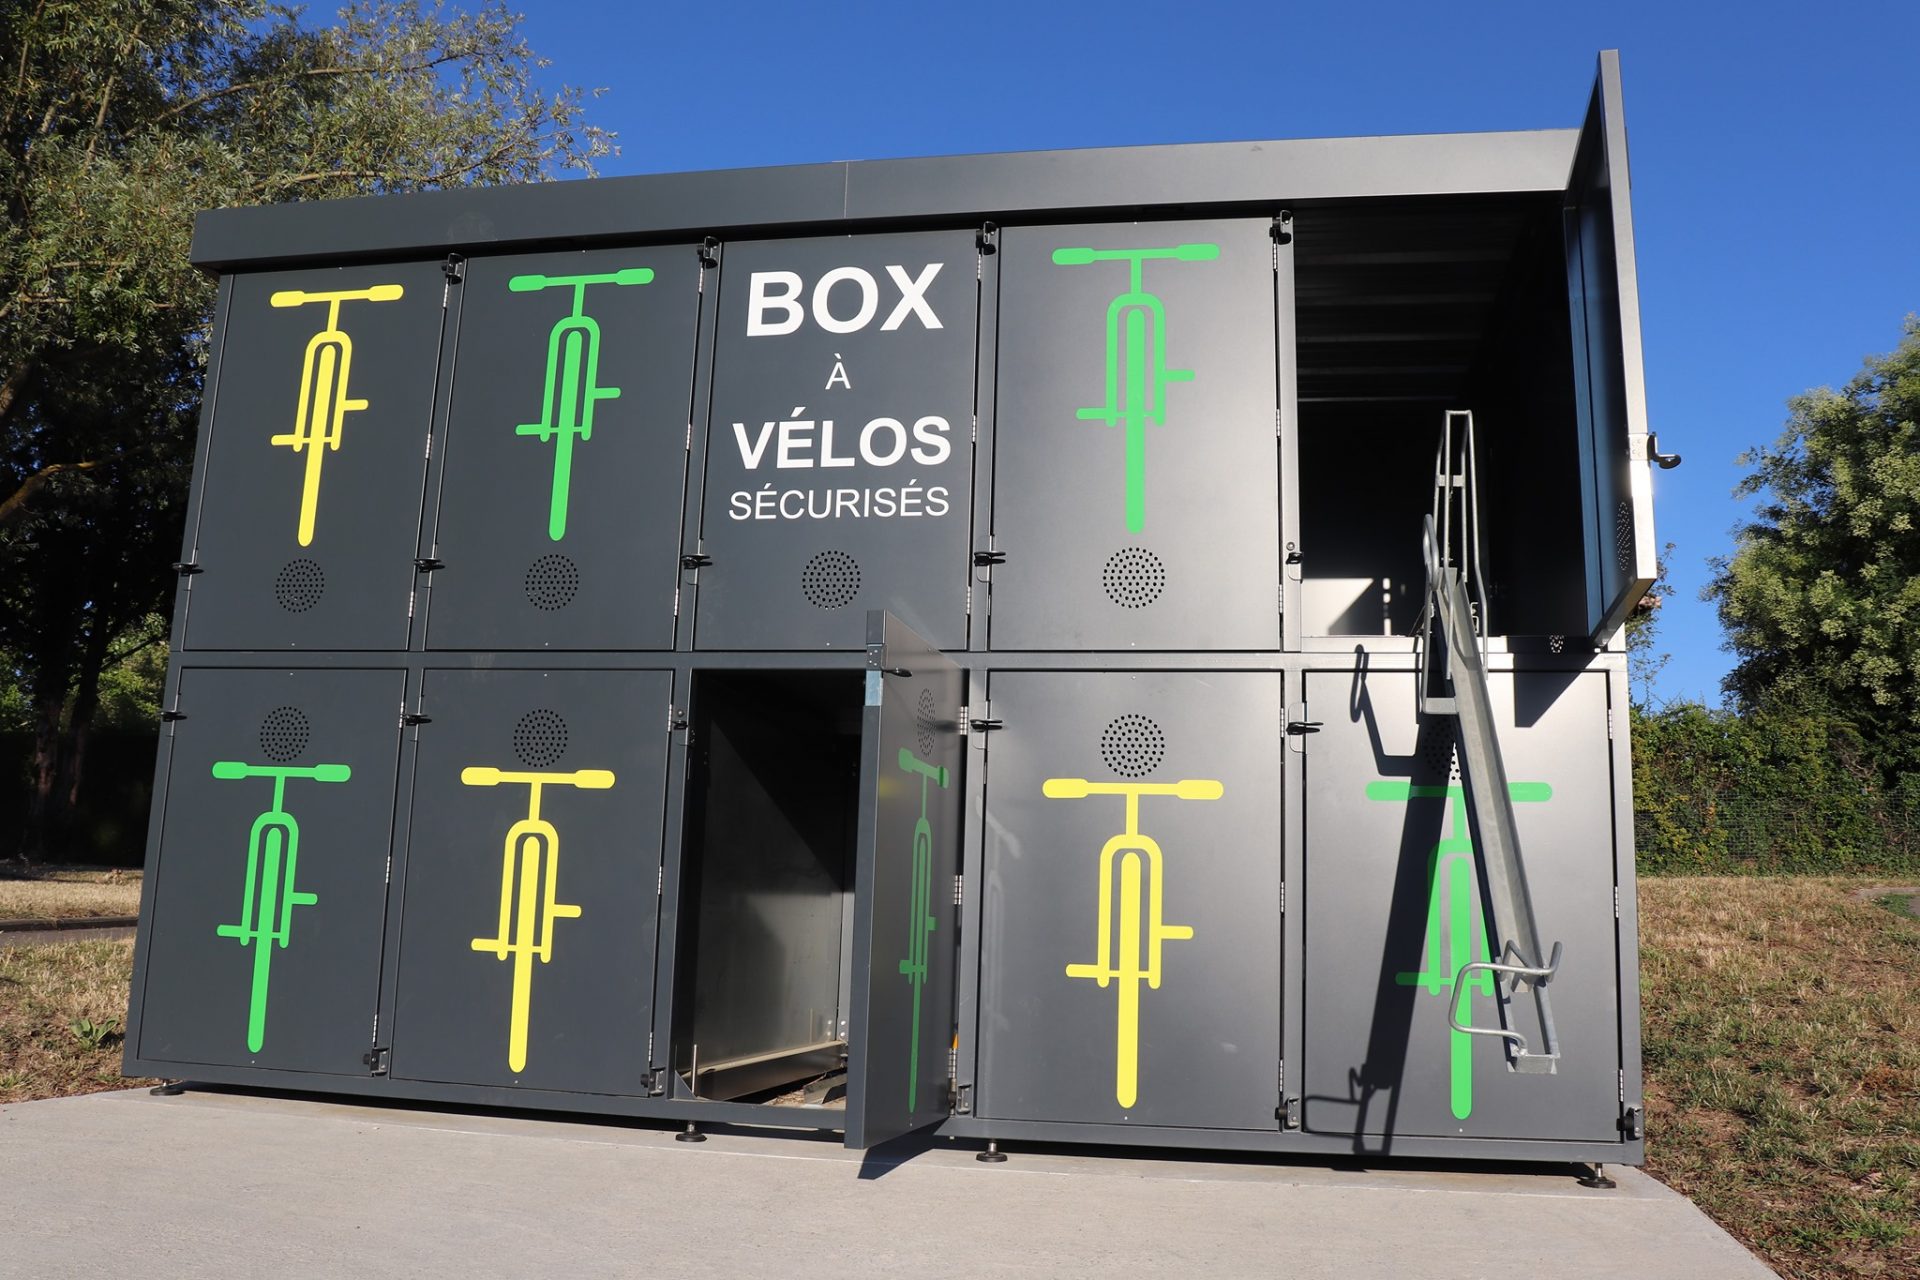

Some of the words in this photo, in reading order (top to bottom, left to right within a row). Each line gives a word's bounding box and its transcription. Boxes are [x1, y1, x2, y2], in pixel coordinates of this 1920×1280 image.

[747, 263, 945, 337] BOX
[824, 352, 852, 390] À
[732, 406, 952, 470] VÉLOS
[728, 478, 950, 521] SÉCURISÉS
